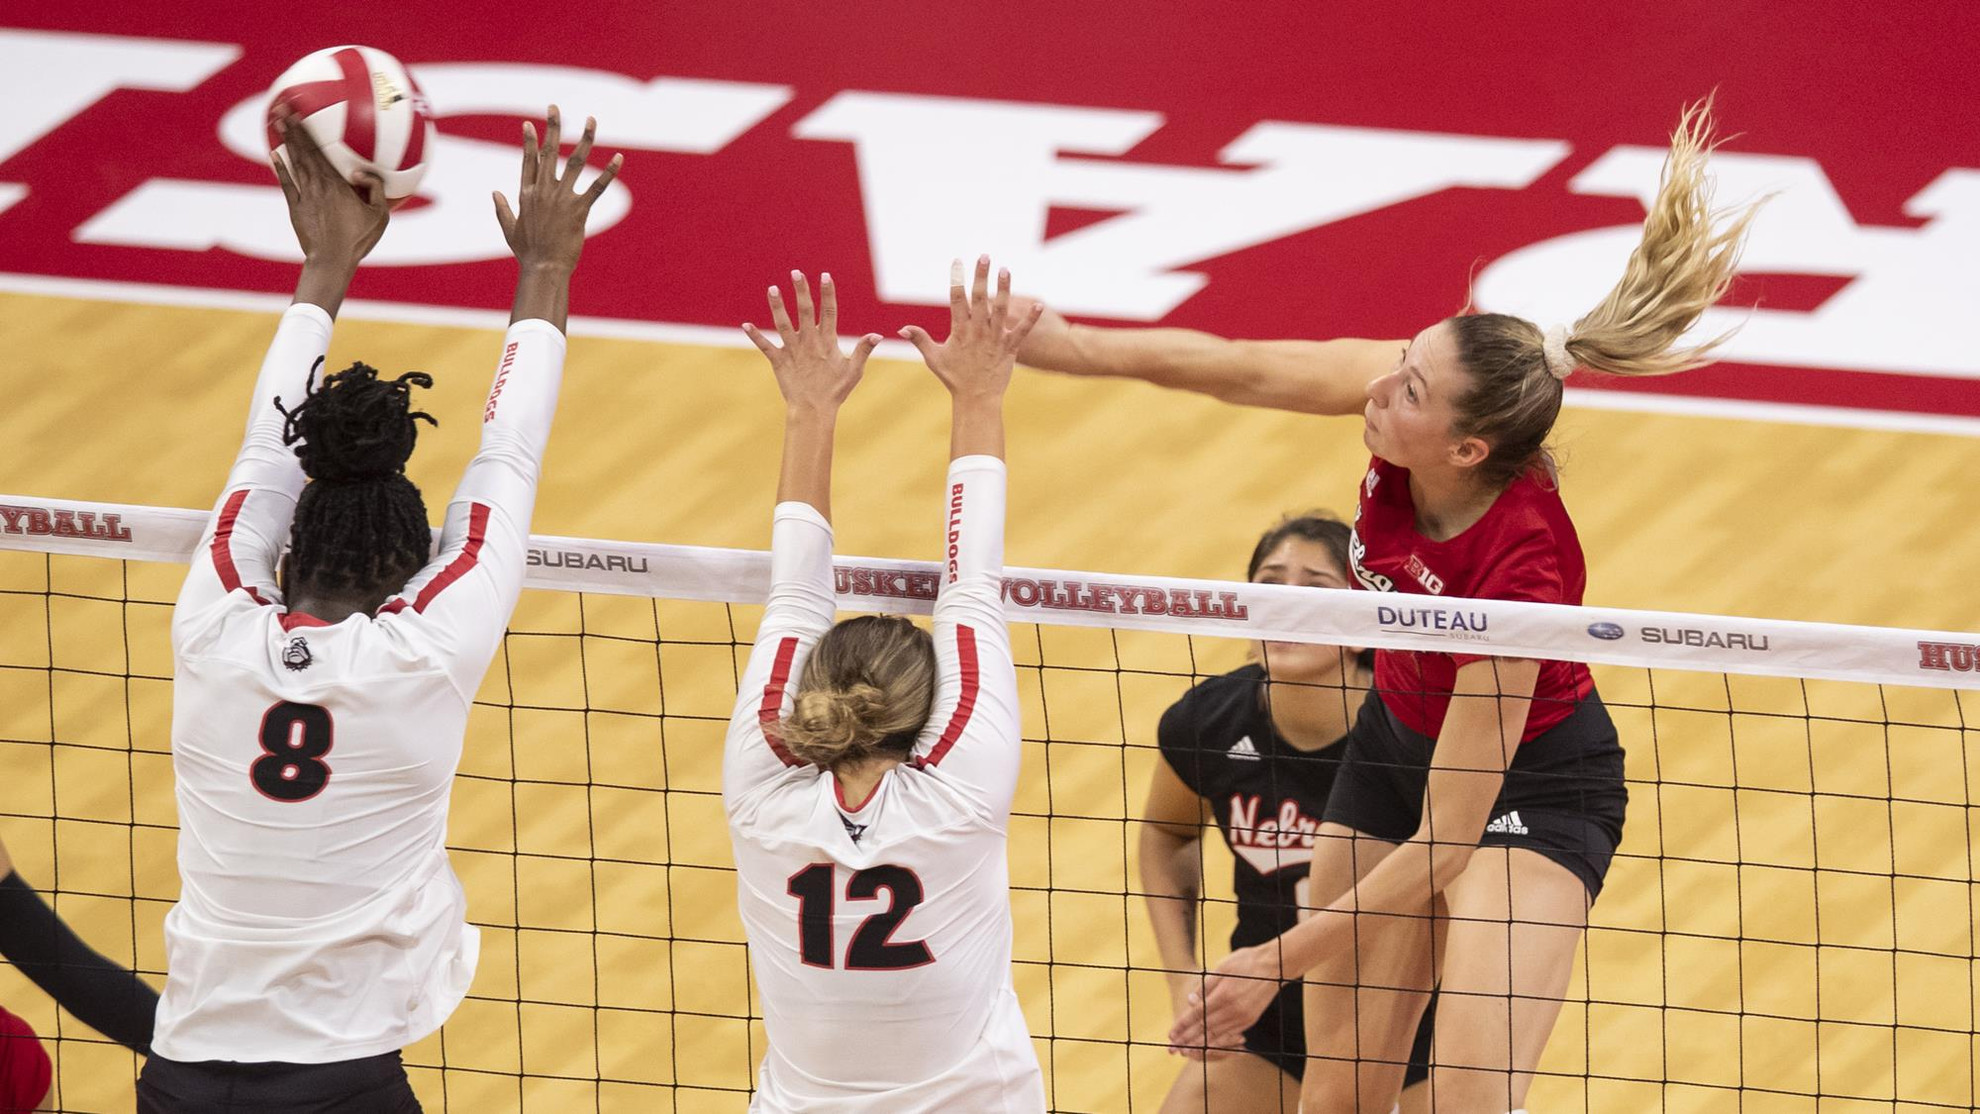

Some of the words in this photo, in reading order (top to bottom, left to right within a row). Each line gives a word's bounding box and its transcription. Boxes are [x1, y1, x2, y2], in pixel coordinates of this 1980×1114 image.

[484, 341, 519, 424] BULLDOGS
[0, 504, 133, 542] YBALL
[948, 483, 964, 585] BULLDOGS
[527, 549, 649, 573] SUBARU
[833, 566, 941, 601] USKE
[1378, 606, 1488, 632] DUTEAU
[1641, 627, 1769, 651] SUBARU
[1917, 641, 1980, 673] HU
[250, 700, 334, 803] 8
[1486, 823, 1529, 835] adidas
[787, 862, 936, 971] 12
